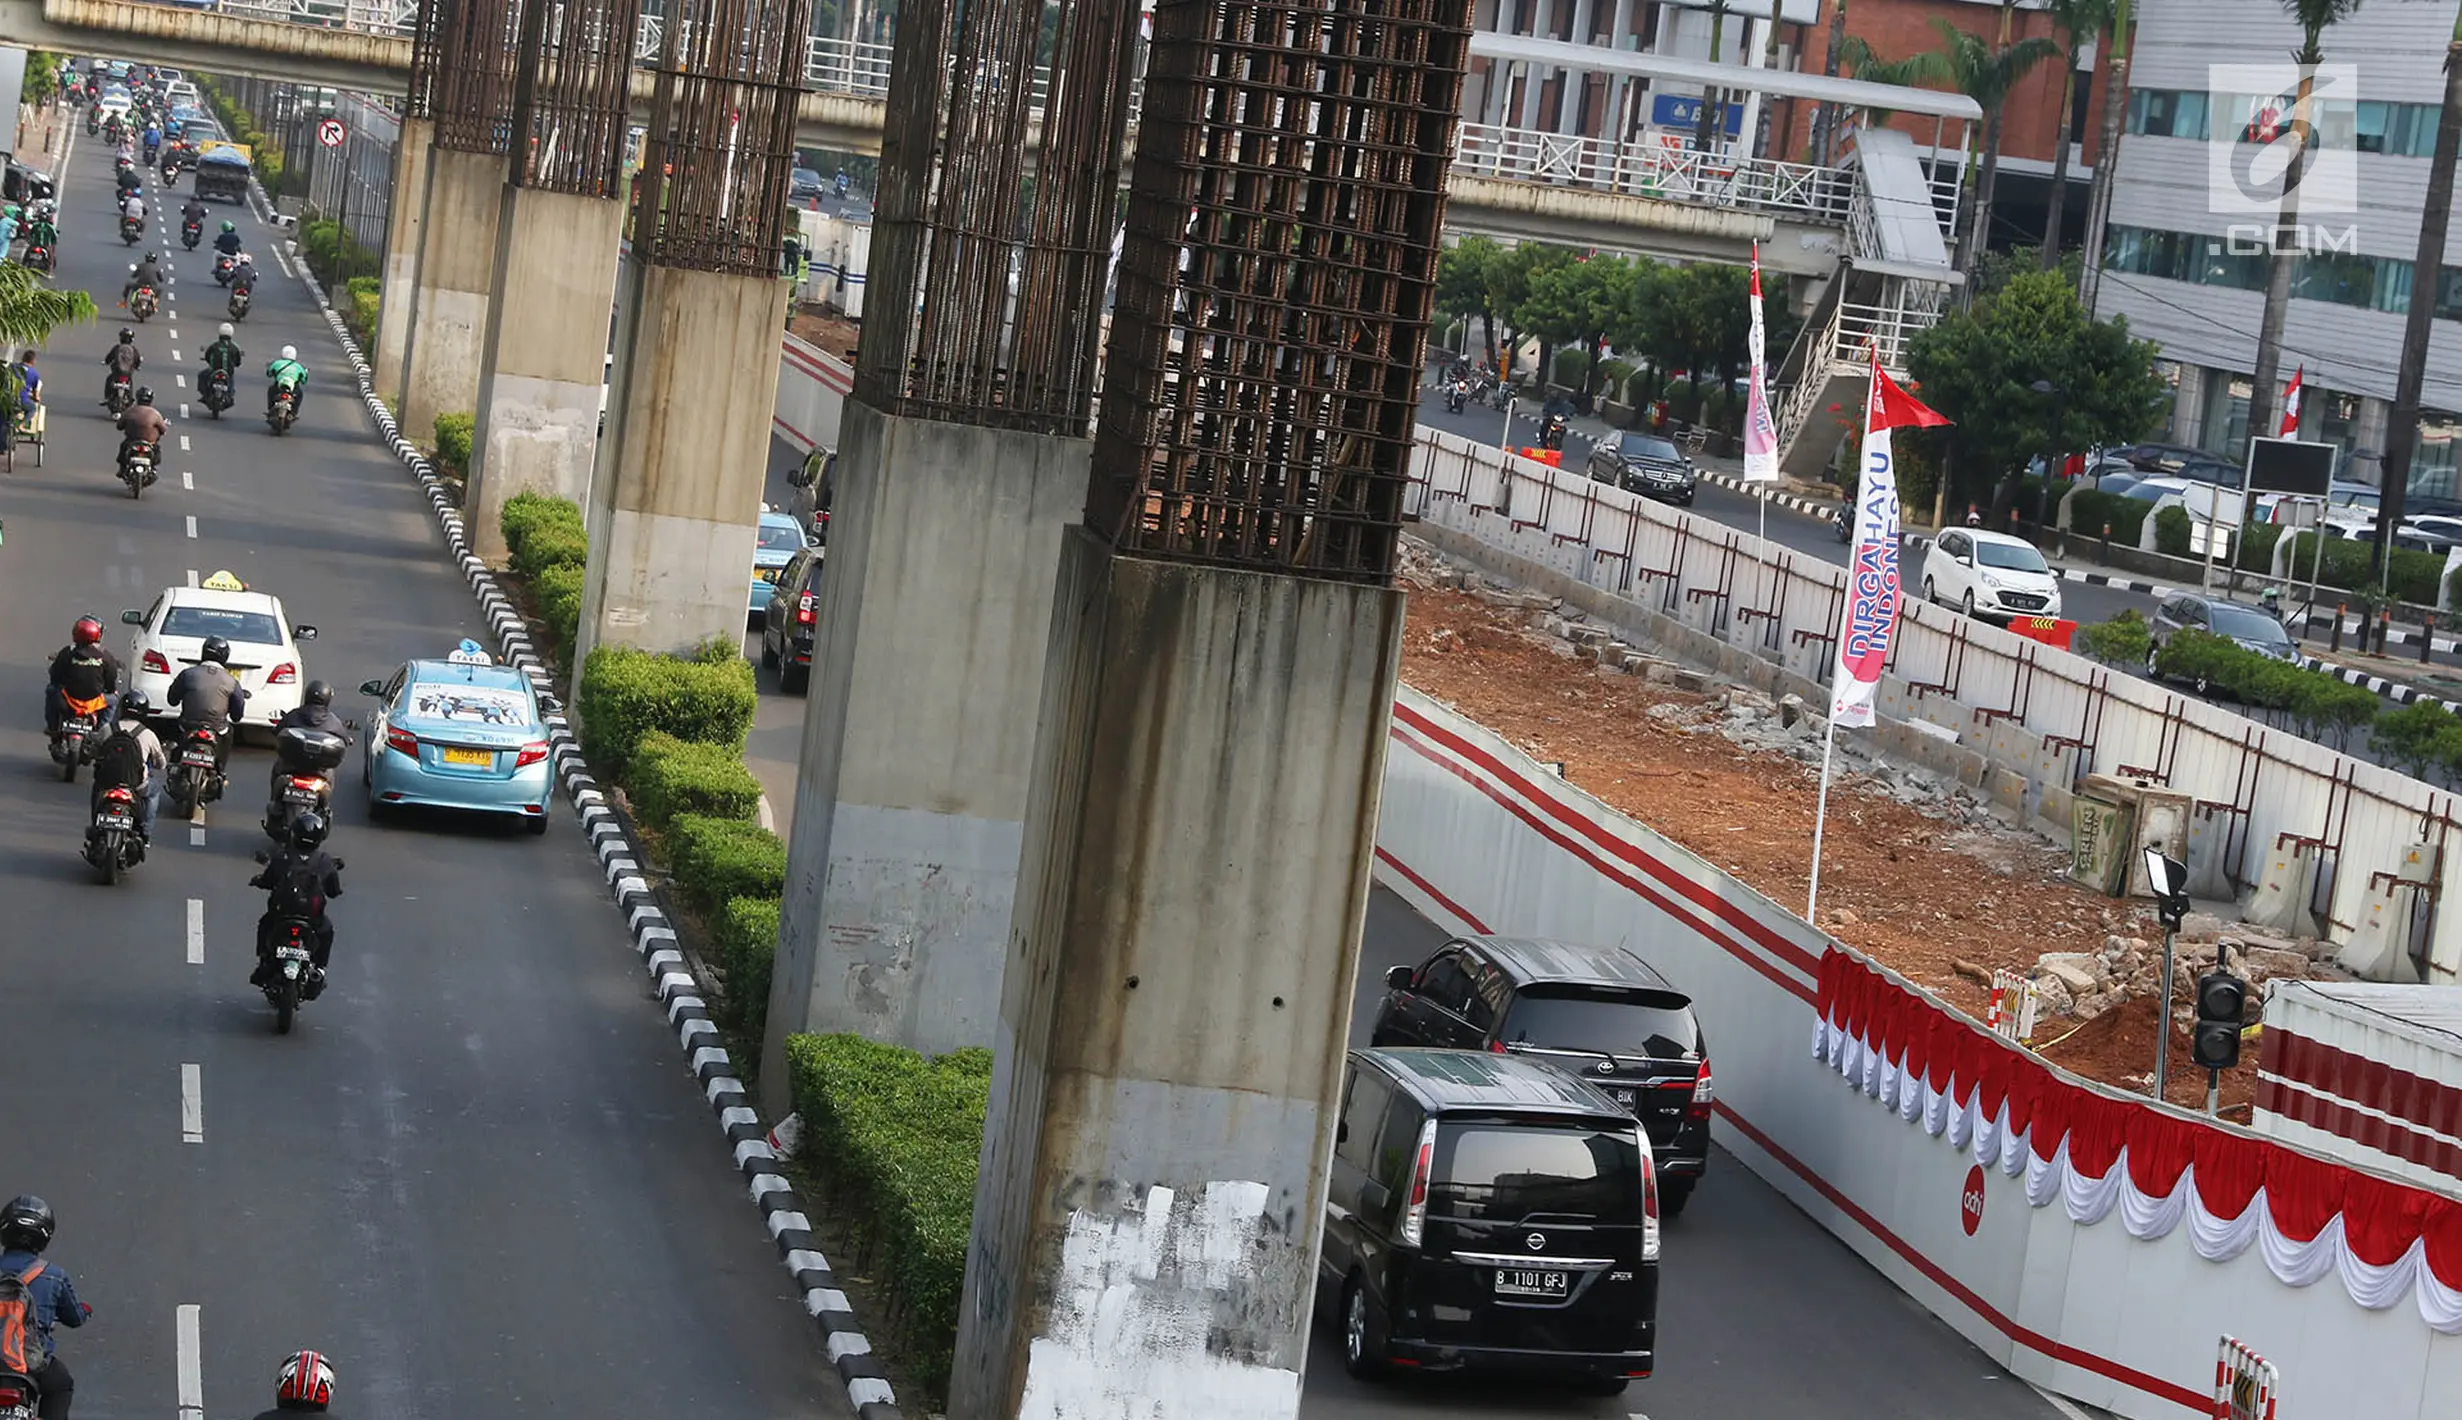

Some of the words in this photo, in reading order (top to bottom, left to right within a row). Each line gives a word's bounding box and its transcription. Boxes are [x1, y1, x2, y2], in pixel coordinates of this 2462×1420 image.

[1847, 451, 1890, 658] DIRGAHAYU
[210, 581, 238, 590] TAKSI
[456, 655, 486, 664] TAKSI
[2080, 806, 2097, 870] GREEN
[1497, 1268, 1505, 1285] B
[1514, 1271, 1540, 1287] 1101
[1544, 1272, 1567, 1289] GFJ
